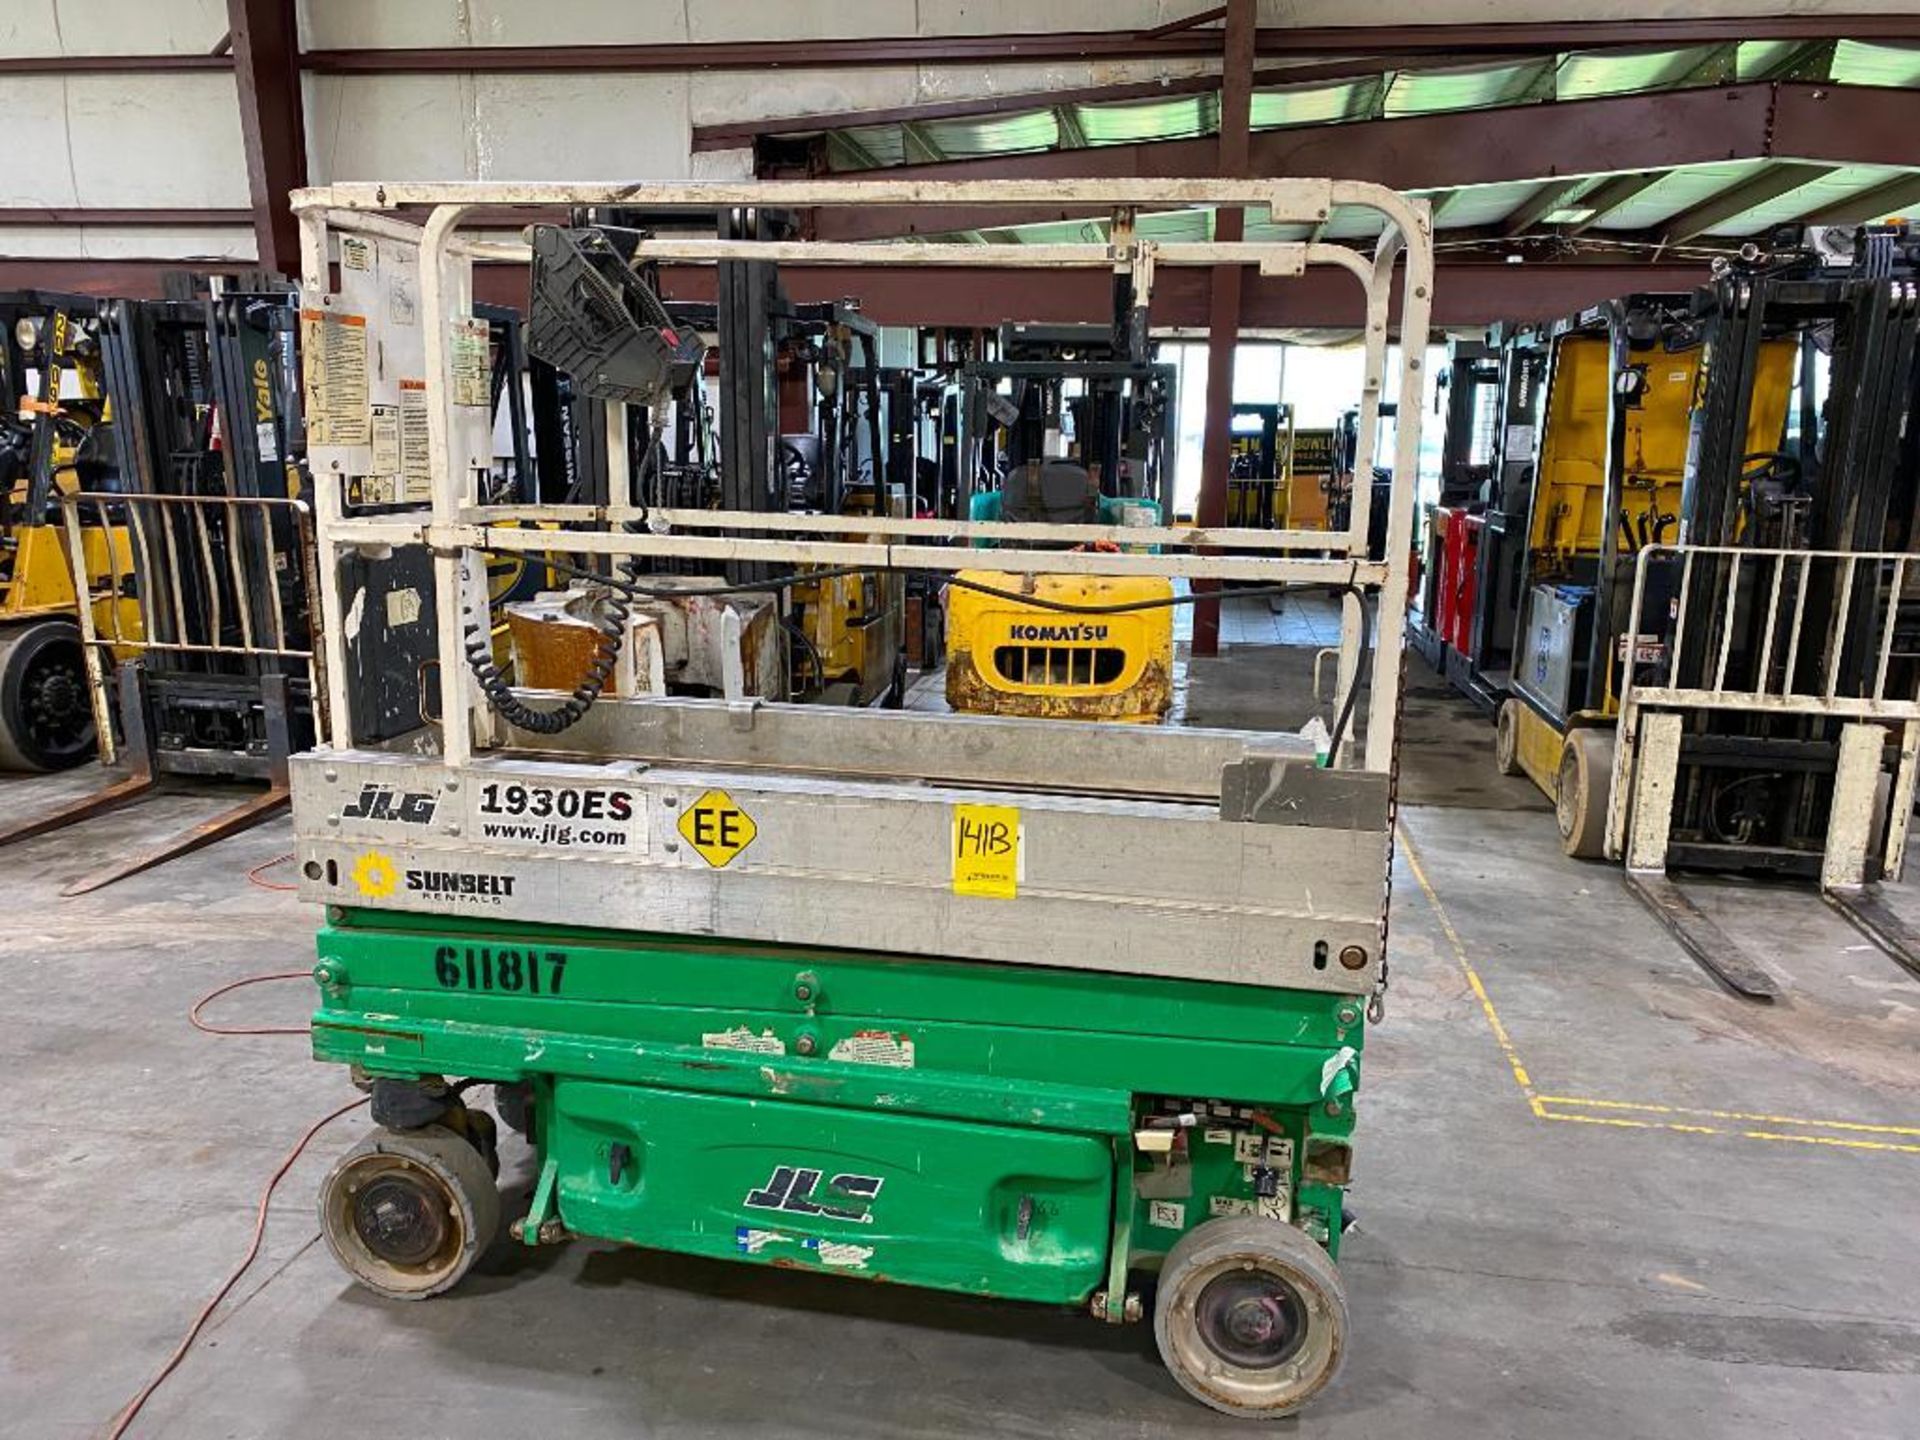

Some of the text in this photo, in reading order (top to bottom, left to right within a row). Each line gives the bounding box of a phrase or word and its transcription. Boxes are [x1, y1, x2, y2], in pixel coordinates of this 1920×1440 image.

[253, 358, 272, 422] Yale
[561, 405, 574, 484] NISSAN
[1010, 623, 1108, 641] KOMATSU
[341, 780, 443, 826] JLG
[480, 783, 633, 821] 1930ES
[483, 823, 627, 846] www.jlg.com
[694, 807, 741, 848] EE
[958, 816, 1012, 859] 141B
[405, 869, 516, 897] SUNBELT
[422, 892, 502, 906] RENTALS
[435, 945, 569, 995] 611817
